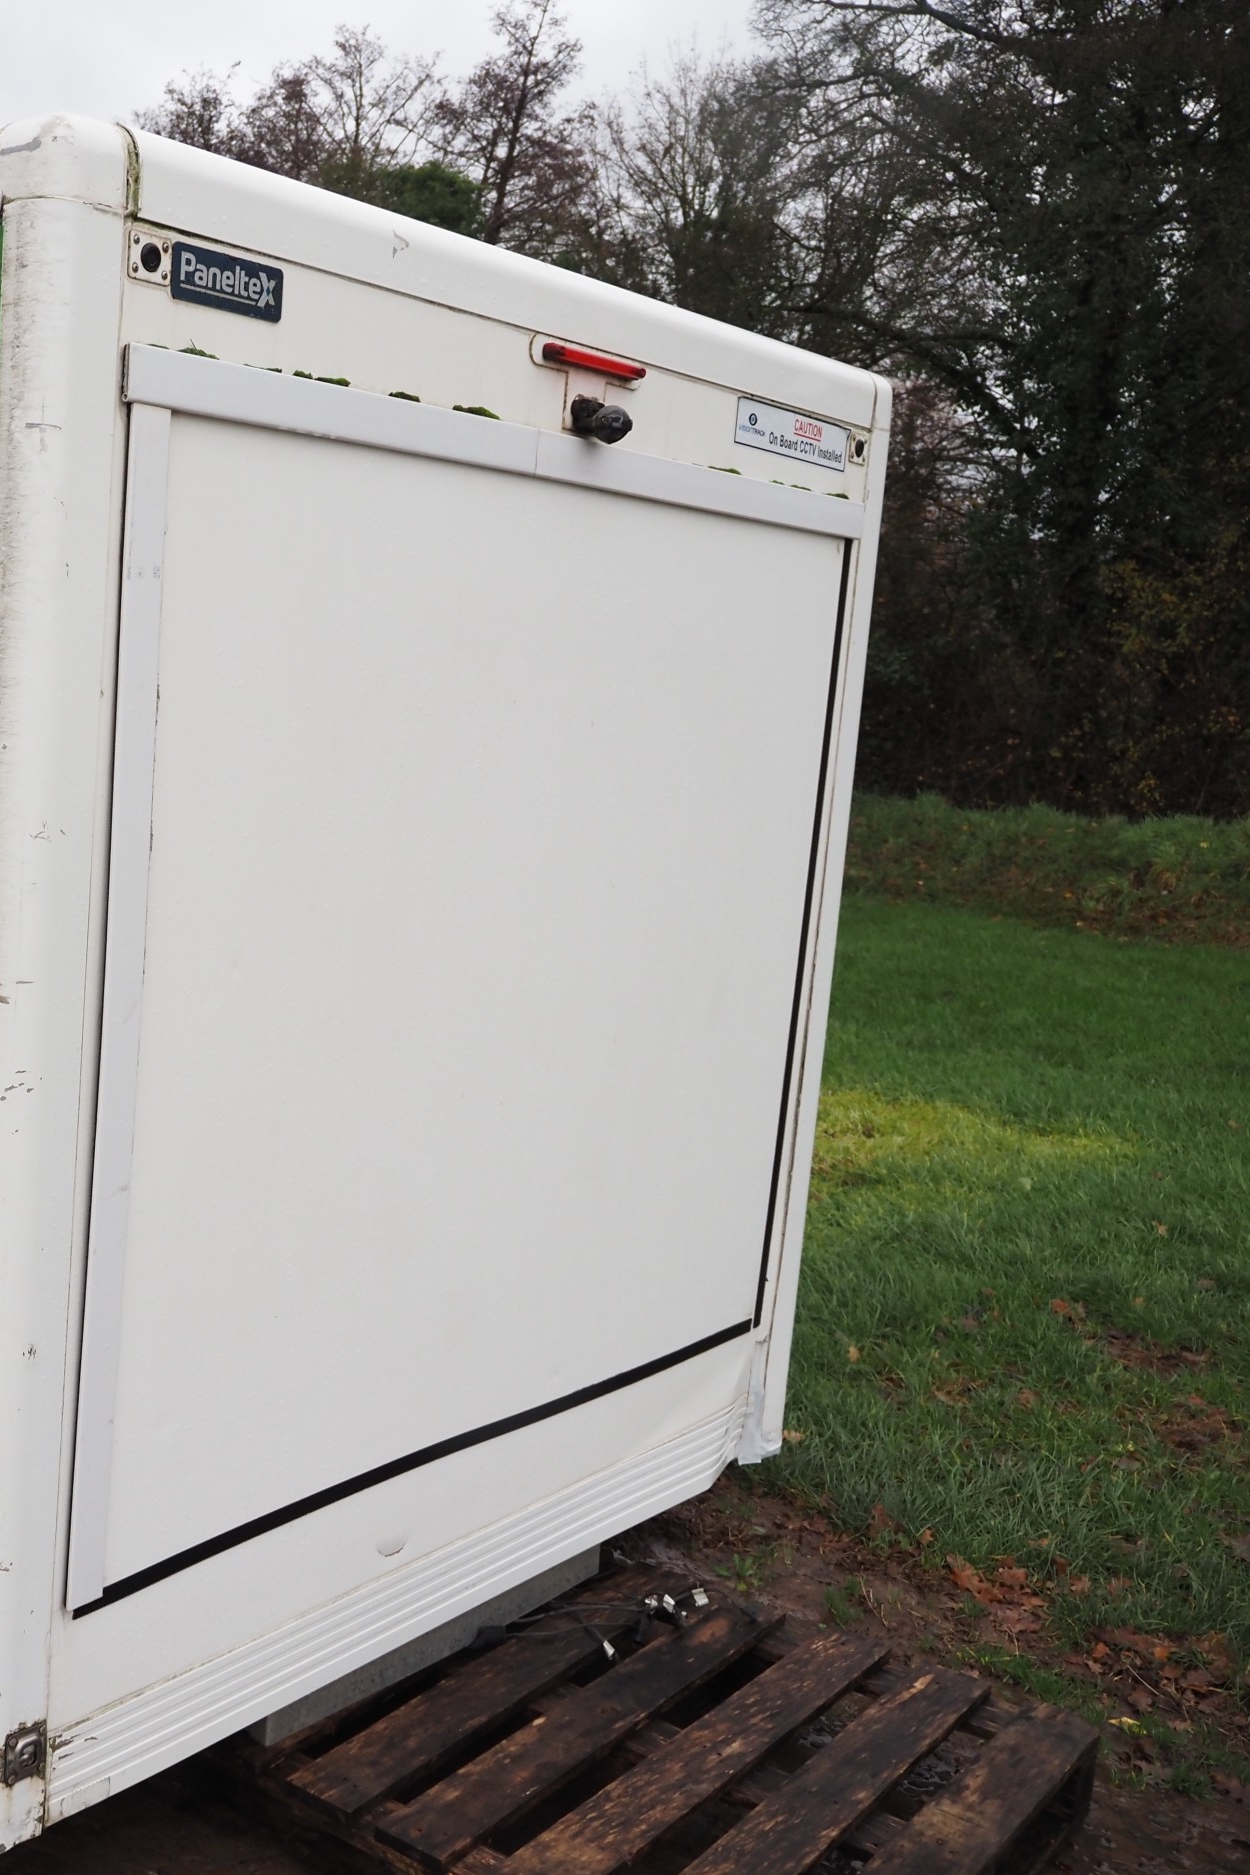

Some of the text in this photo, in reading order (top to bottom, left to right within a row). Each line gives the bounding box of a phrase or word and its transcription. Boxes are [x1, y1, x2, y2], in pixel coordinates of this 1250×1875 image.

[794, 418, 823, 438] CAUTION
[768, 431, 842, 464] On Board CCTV Installed
